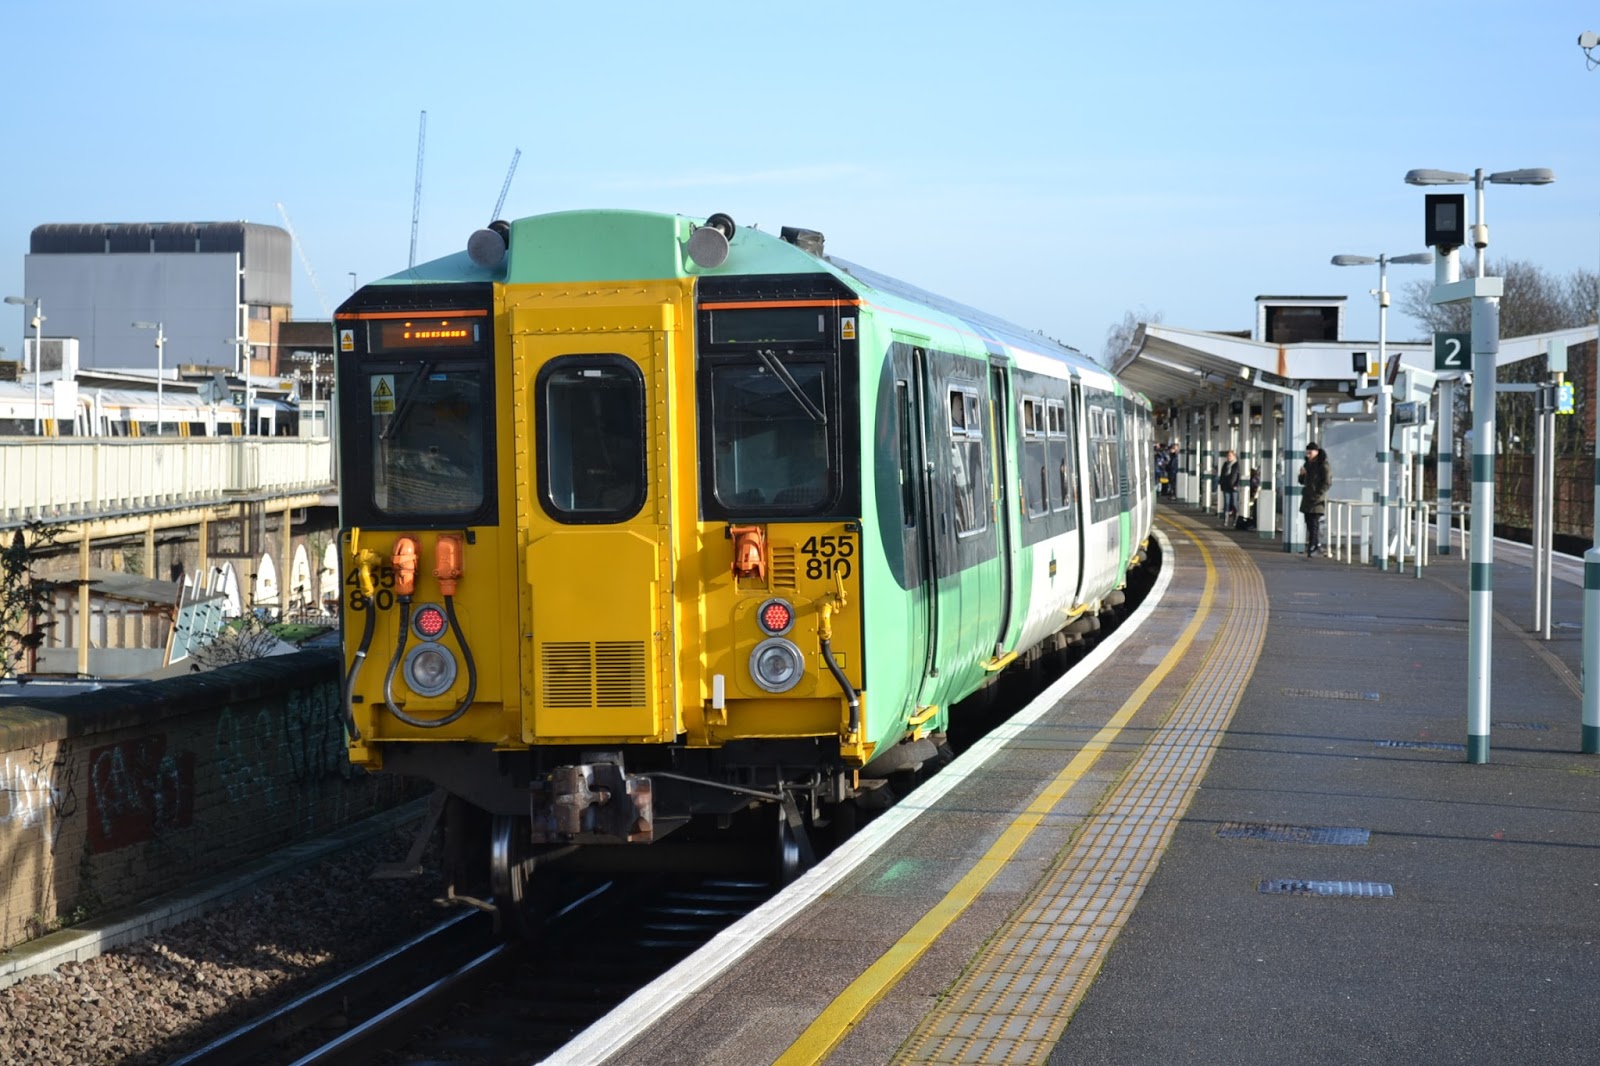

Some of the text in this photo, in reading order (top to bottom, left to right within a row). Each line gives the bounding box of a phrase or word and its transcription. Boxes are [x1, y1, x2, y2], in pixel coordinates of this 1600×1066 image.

[1444, 338, 1461, 366] 2
[235, 393, 243, 405] 3
[800, 535, 854, 558] 455
[806, 558, 851, 580] 810
[350, 589, 394, 611] 80
